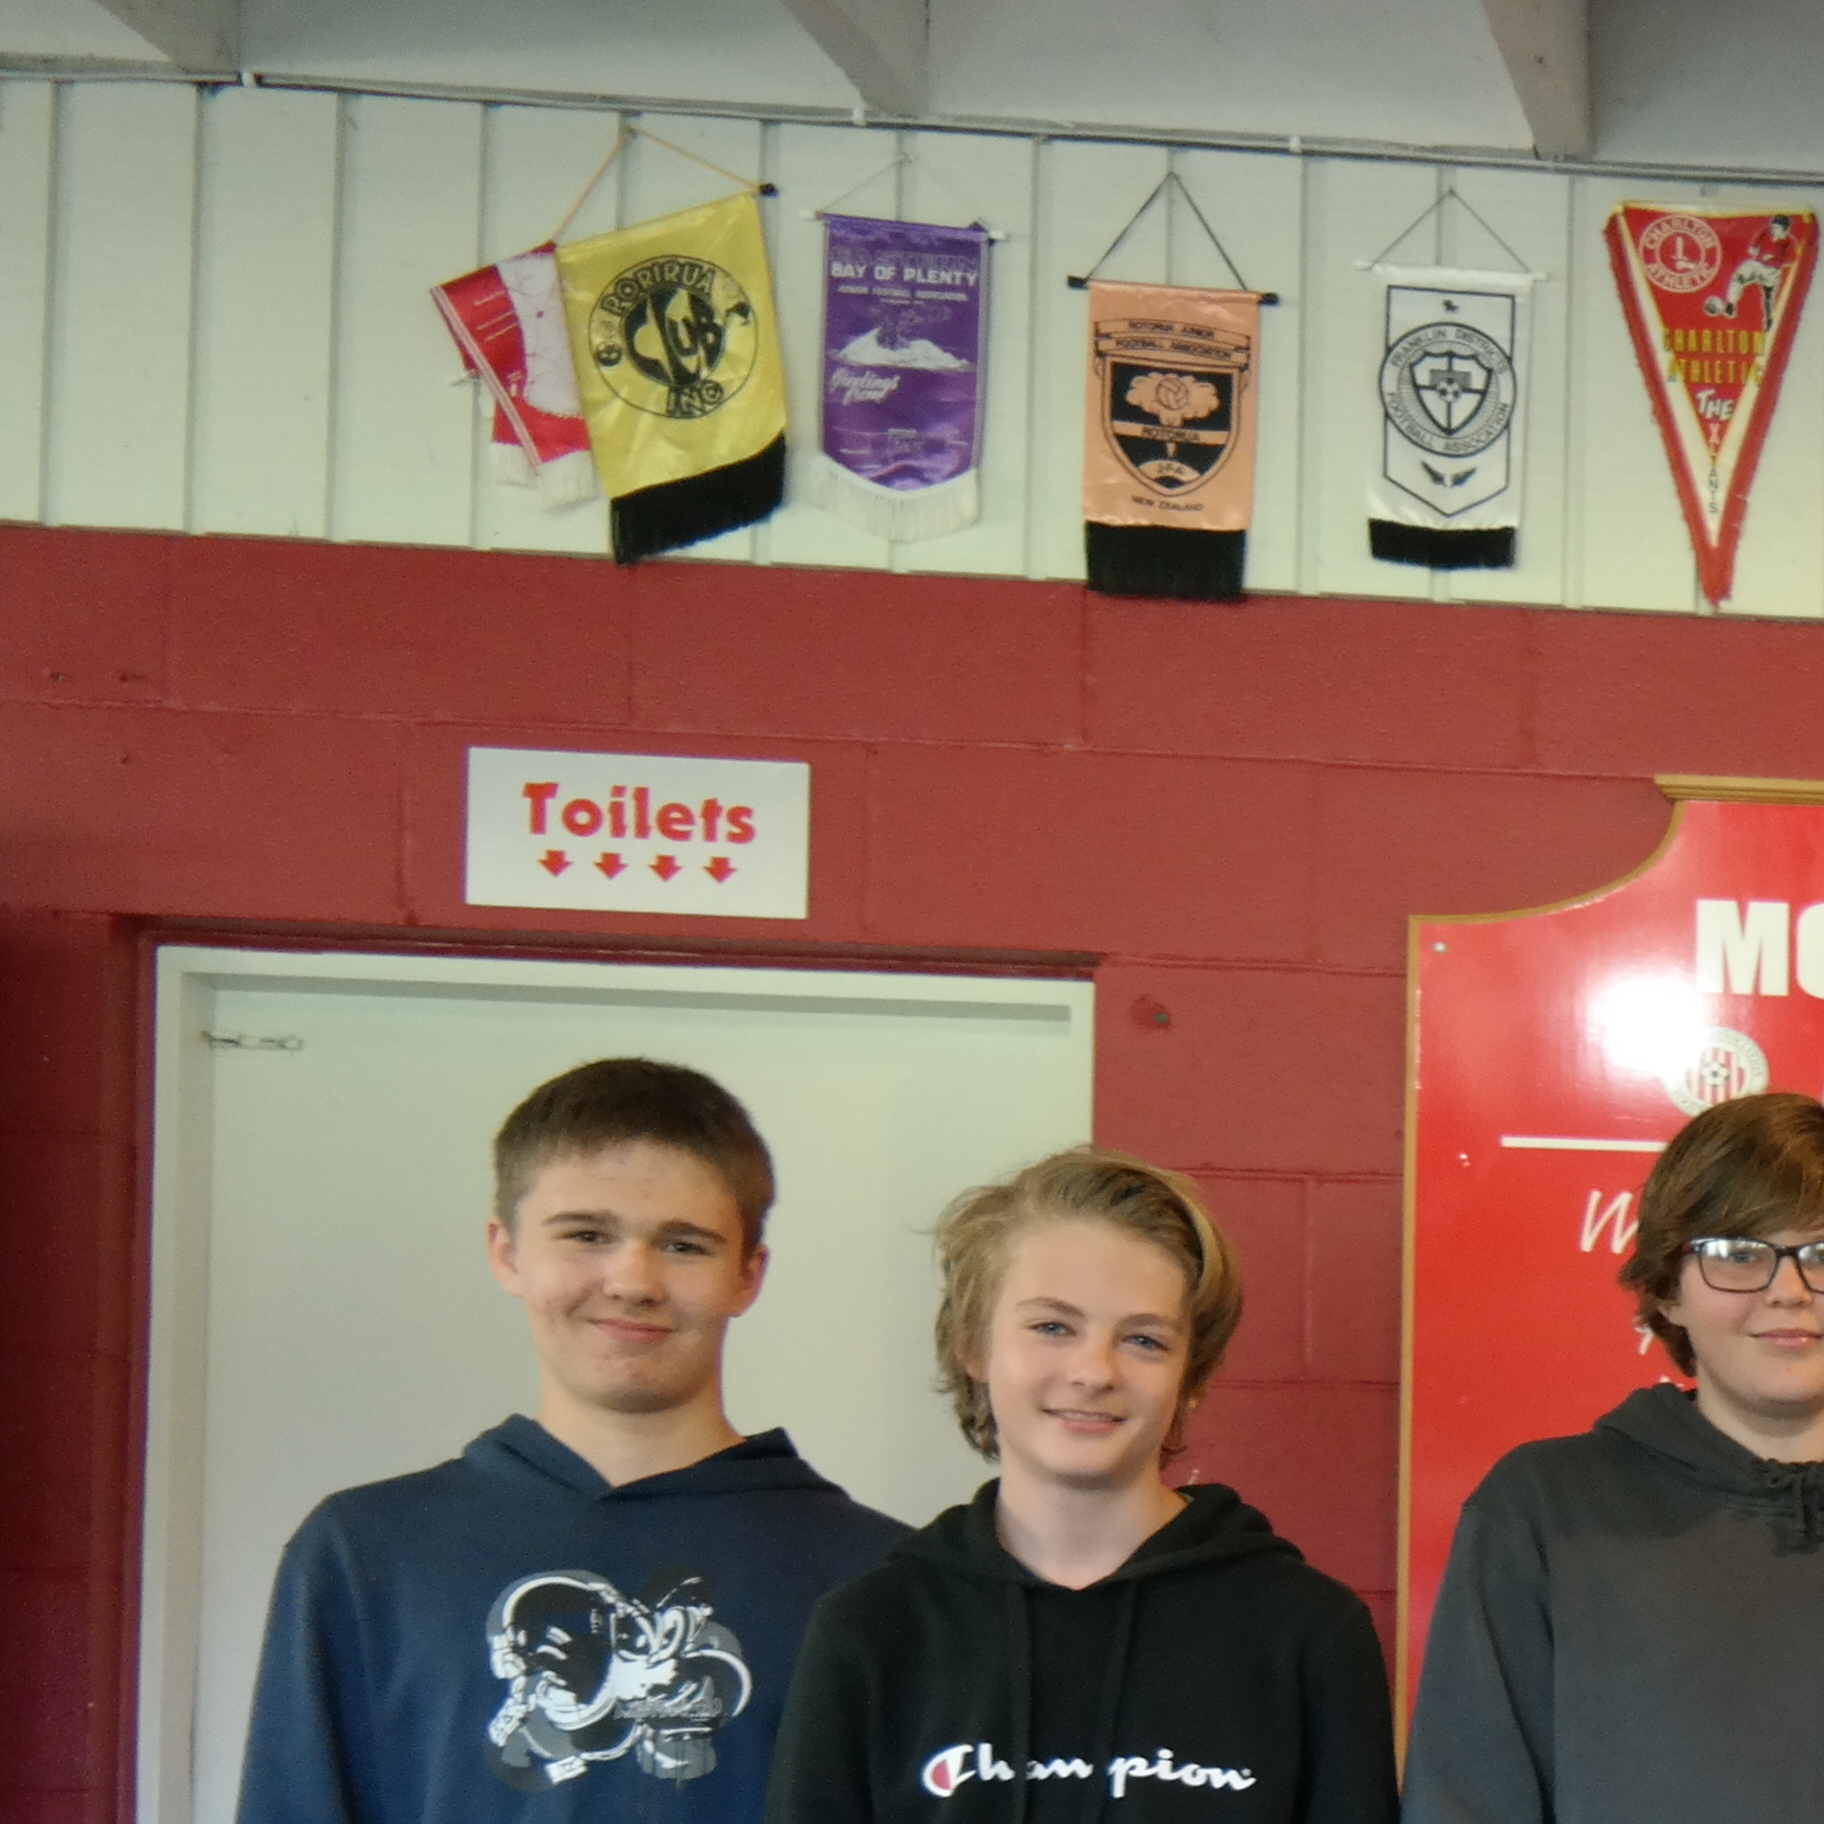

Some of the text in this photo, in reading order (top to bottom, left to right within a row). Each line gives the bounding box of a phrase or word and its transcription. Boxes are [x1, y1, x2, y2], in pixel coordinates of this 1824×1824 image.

[1644, 215, 1718, 250] CHARLTON
[831, 262, 978, 287] BAY OF PLENTY
[1662, 328, 1767, 355] CHARLTON
[1668, 357, 1764, 385] ATHLETIC
[1695, 388, 1734, 421] THE
[1141, 425, 1200, 443] ROTORUA
[1131, 494, 1205, 513] NEW ZEALAND
[522, 782, 757, 845] Toilets
[921, 1742, 1257, 1799] Champion
